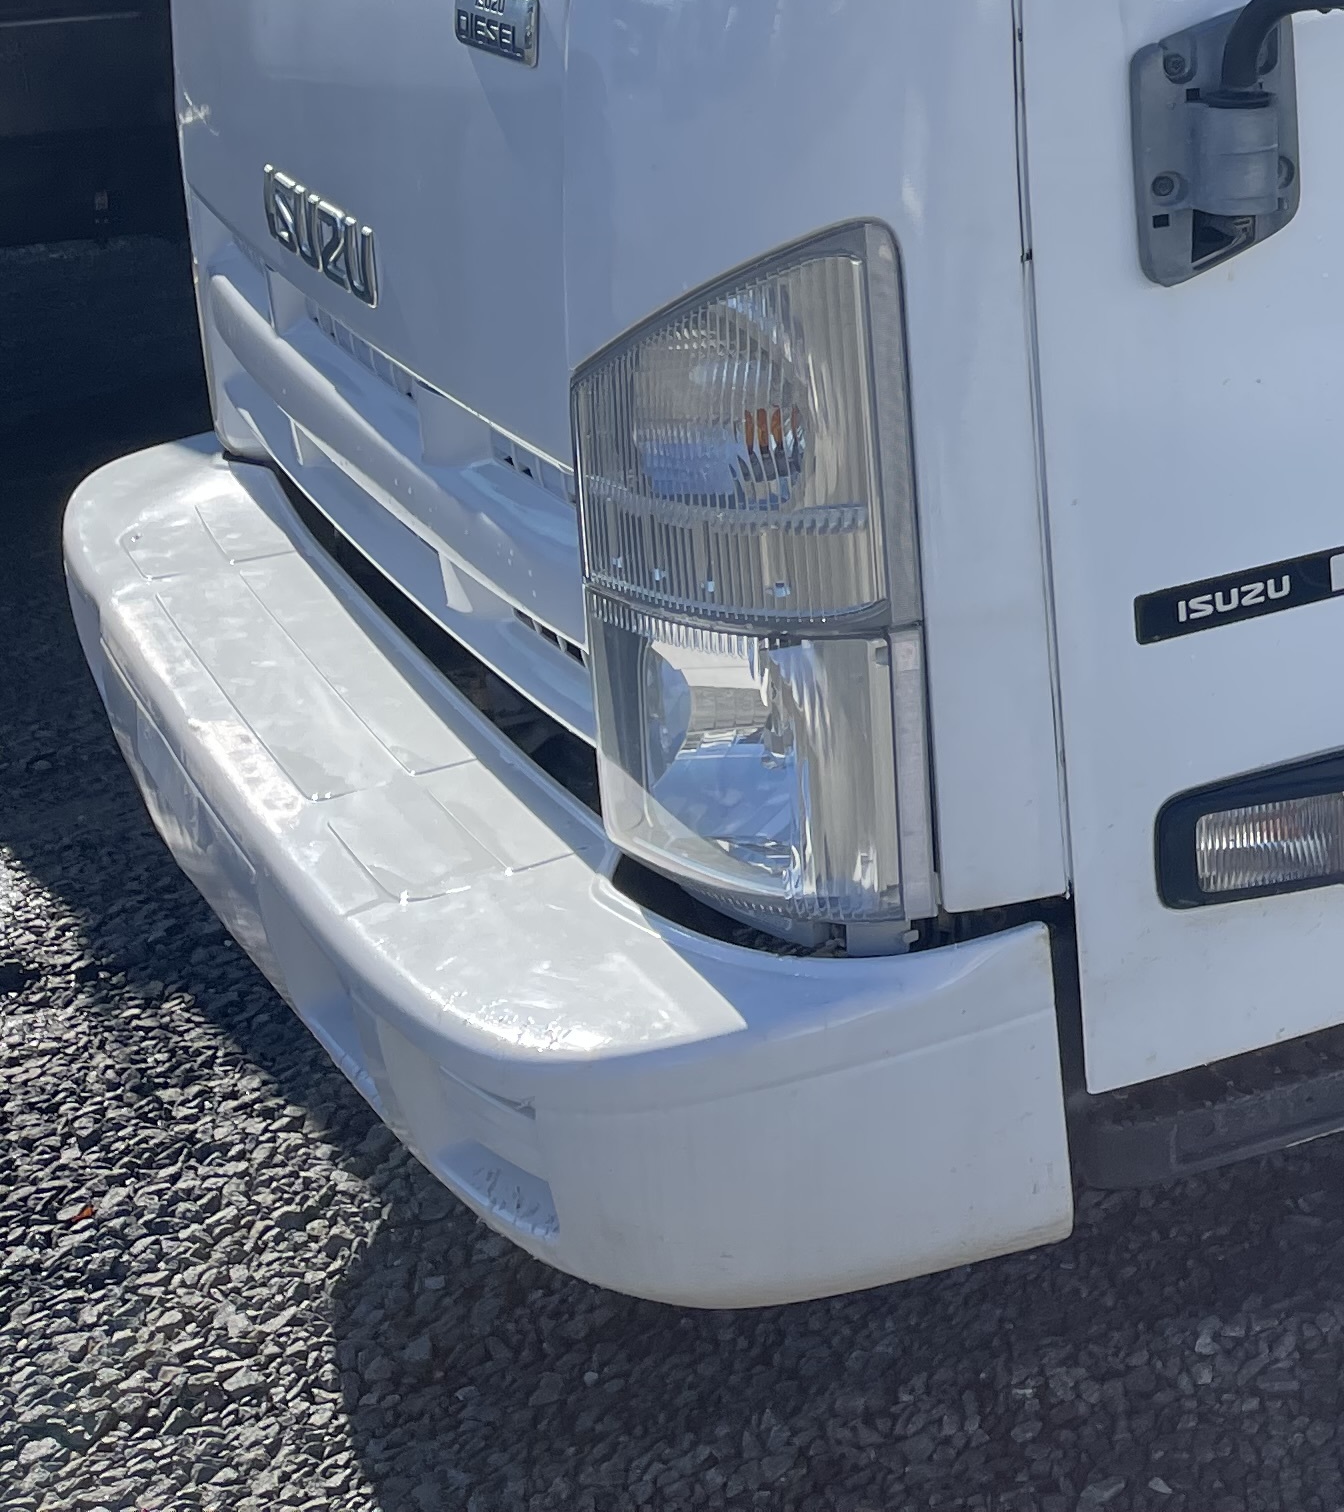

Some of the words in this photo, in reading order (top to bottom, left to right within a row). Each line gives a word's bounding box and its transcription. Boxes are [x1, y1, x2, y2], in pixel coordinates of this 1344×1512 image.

[456, 9, 526, 58] DIESEL
[263, 164, 379, 309] ISUZU
[1177, 574, 1291, 622] ISUZU
